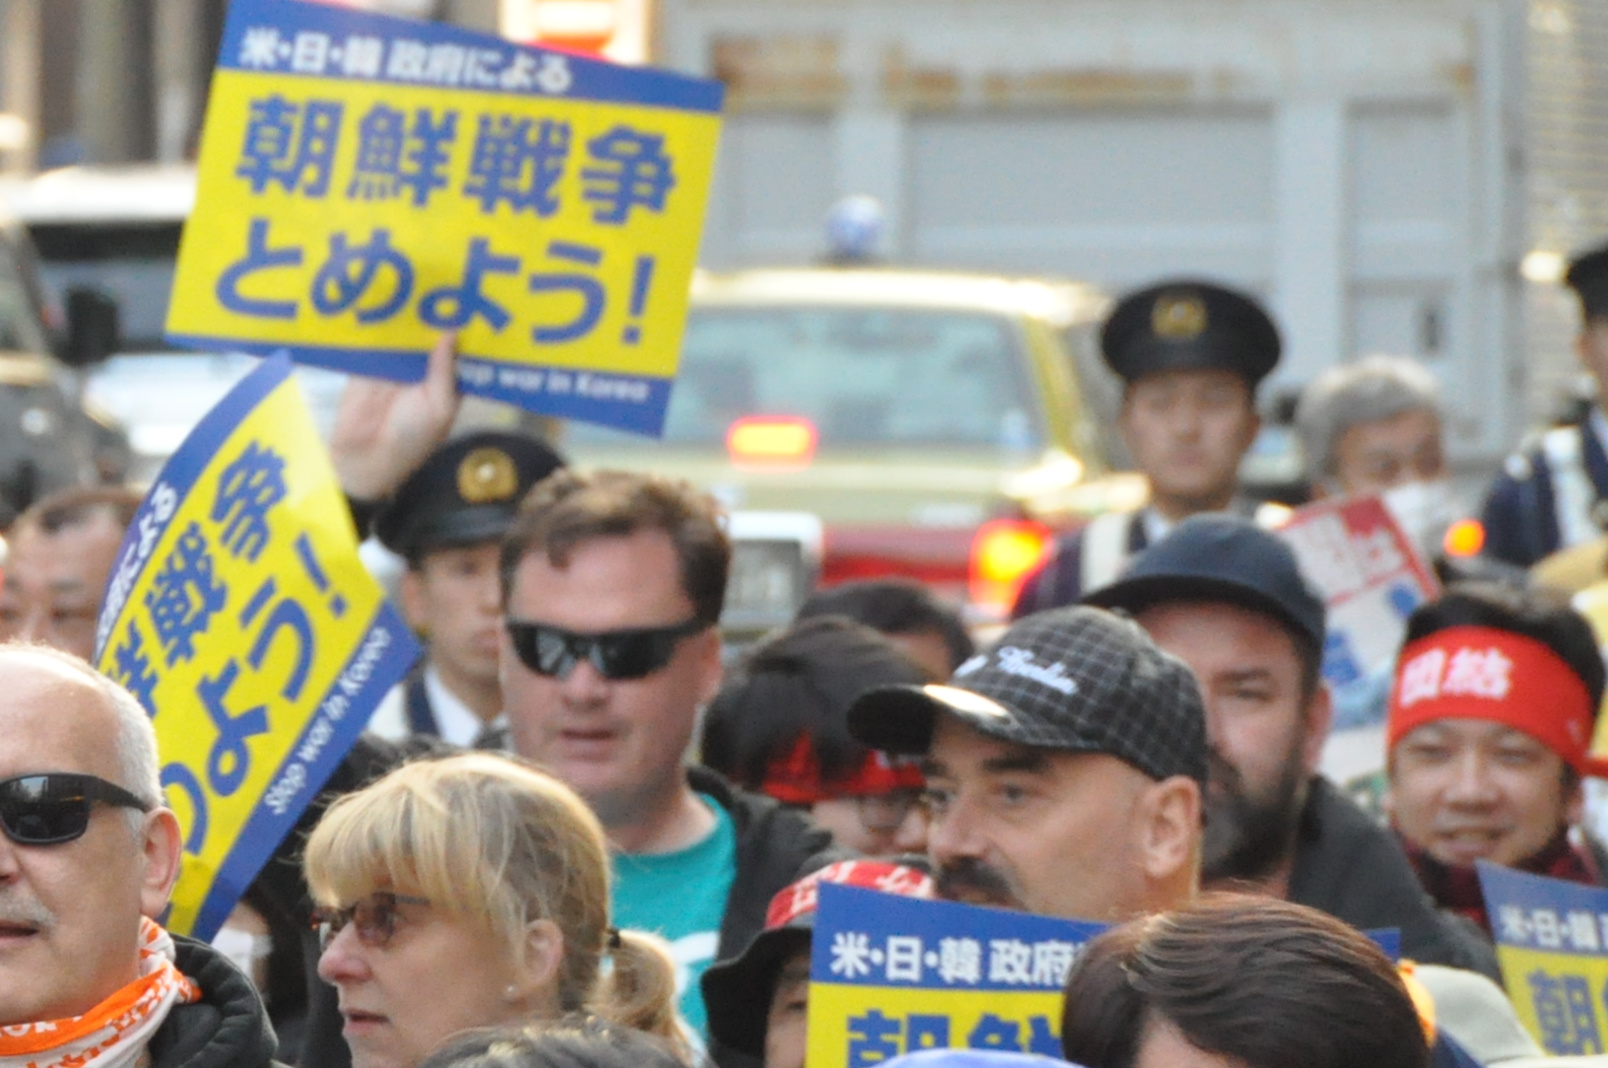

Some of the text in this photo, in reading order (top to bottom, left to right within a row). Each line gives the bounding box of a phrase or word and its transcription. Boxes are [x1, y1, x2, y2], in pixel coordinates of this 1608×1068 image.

[234, 94, 677, 226] 朝鮮戦争
[214, 218, 655, 346] とめよう！
[296, 717, 334, 763] war
[338, 626, 391, 697] Korea
